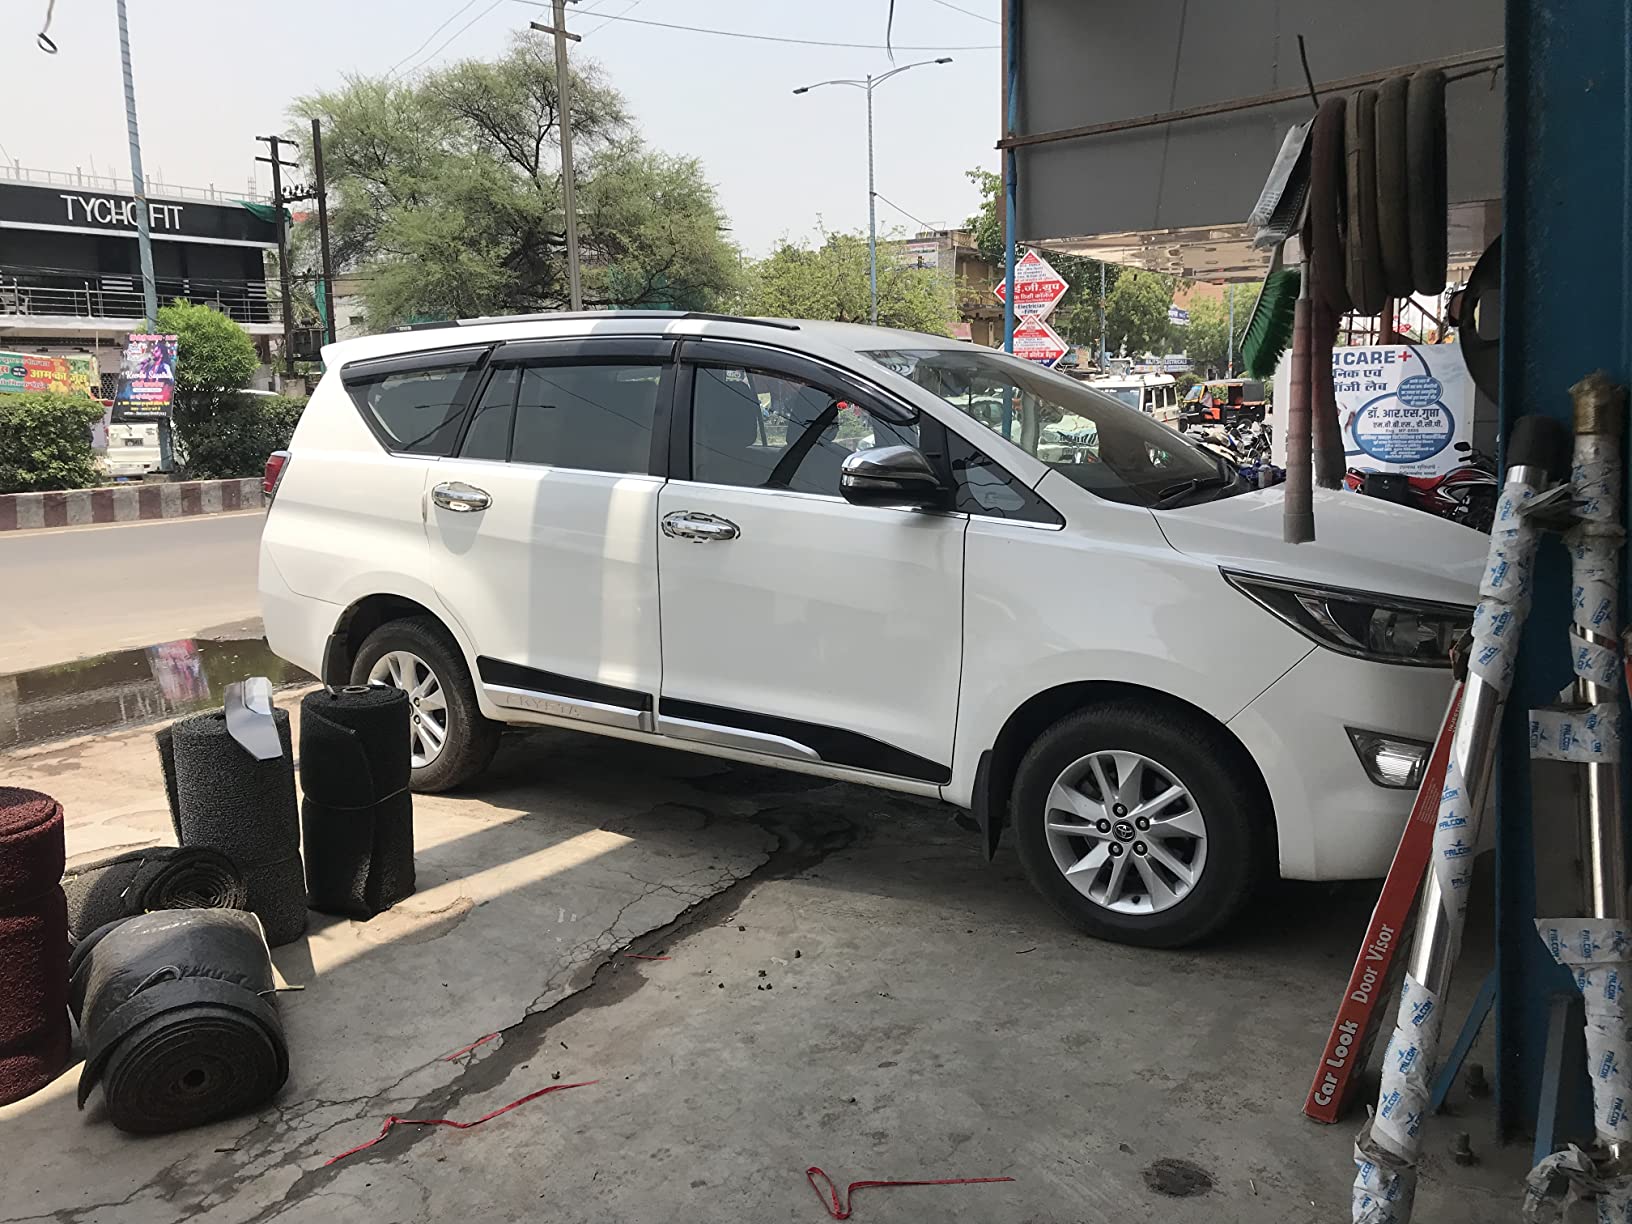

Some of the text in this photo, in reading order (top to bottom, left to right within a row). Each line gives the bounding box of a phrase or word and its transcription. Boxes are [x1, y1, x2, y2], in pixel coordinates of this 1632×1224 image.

[148, 203, 184, 230] FIT
[1439, 817, 1467, 829] FALCON
[1313, 922, 1395, 1107] Car Look Door Visor
[1412, 1000, 1433, 1026] FALCON
[1399, 1046, 1417, 1073] FALCON
[1381, 1090, 1400, 1117] FALCON
